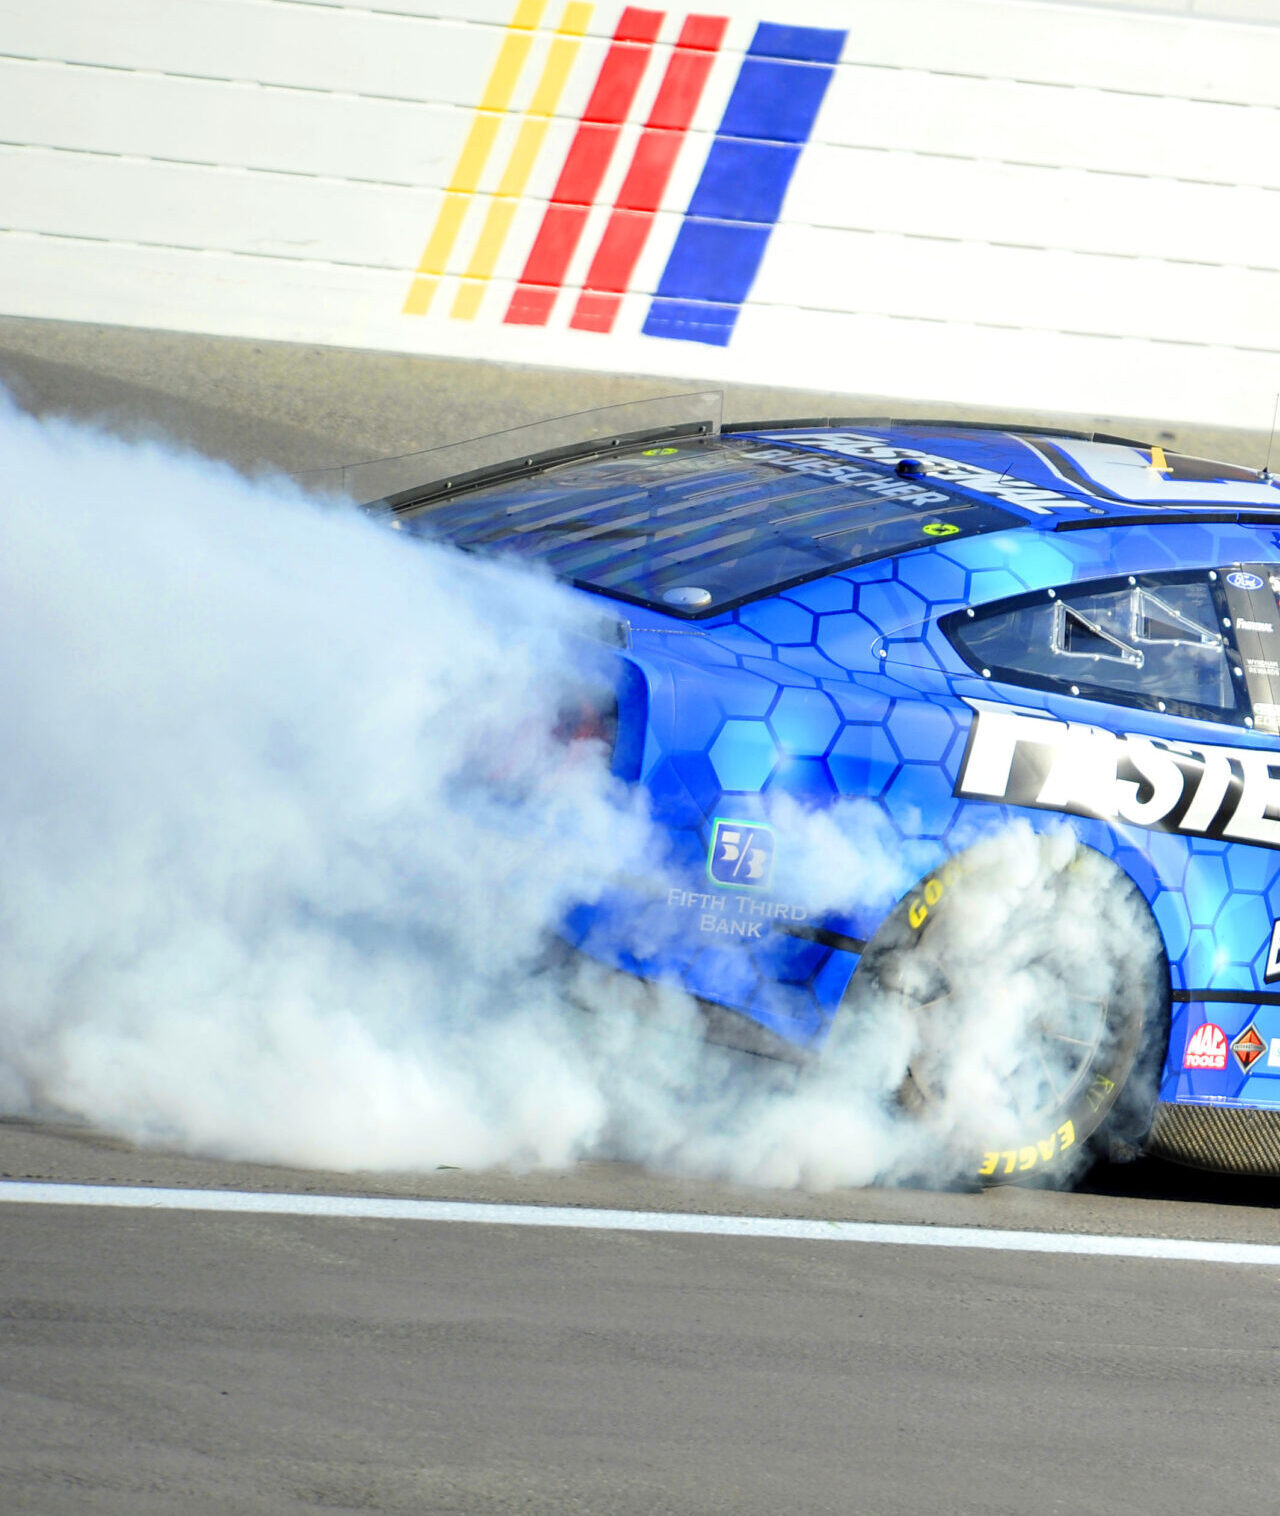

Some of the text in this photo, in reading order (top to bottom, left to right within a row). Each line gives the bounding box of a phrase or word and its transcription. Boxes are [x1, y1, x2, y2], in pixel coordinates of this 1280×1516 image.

[743, 449, 950, 506] BUESCHER
[1186, 1054, 1225, 1068] TOOLS
[1187, 1024, 1226, 1055] MAC
[978, 1120, 1076, 1175] EAGLE
